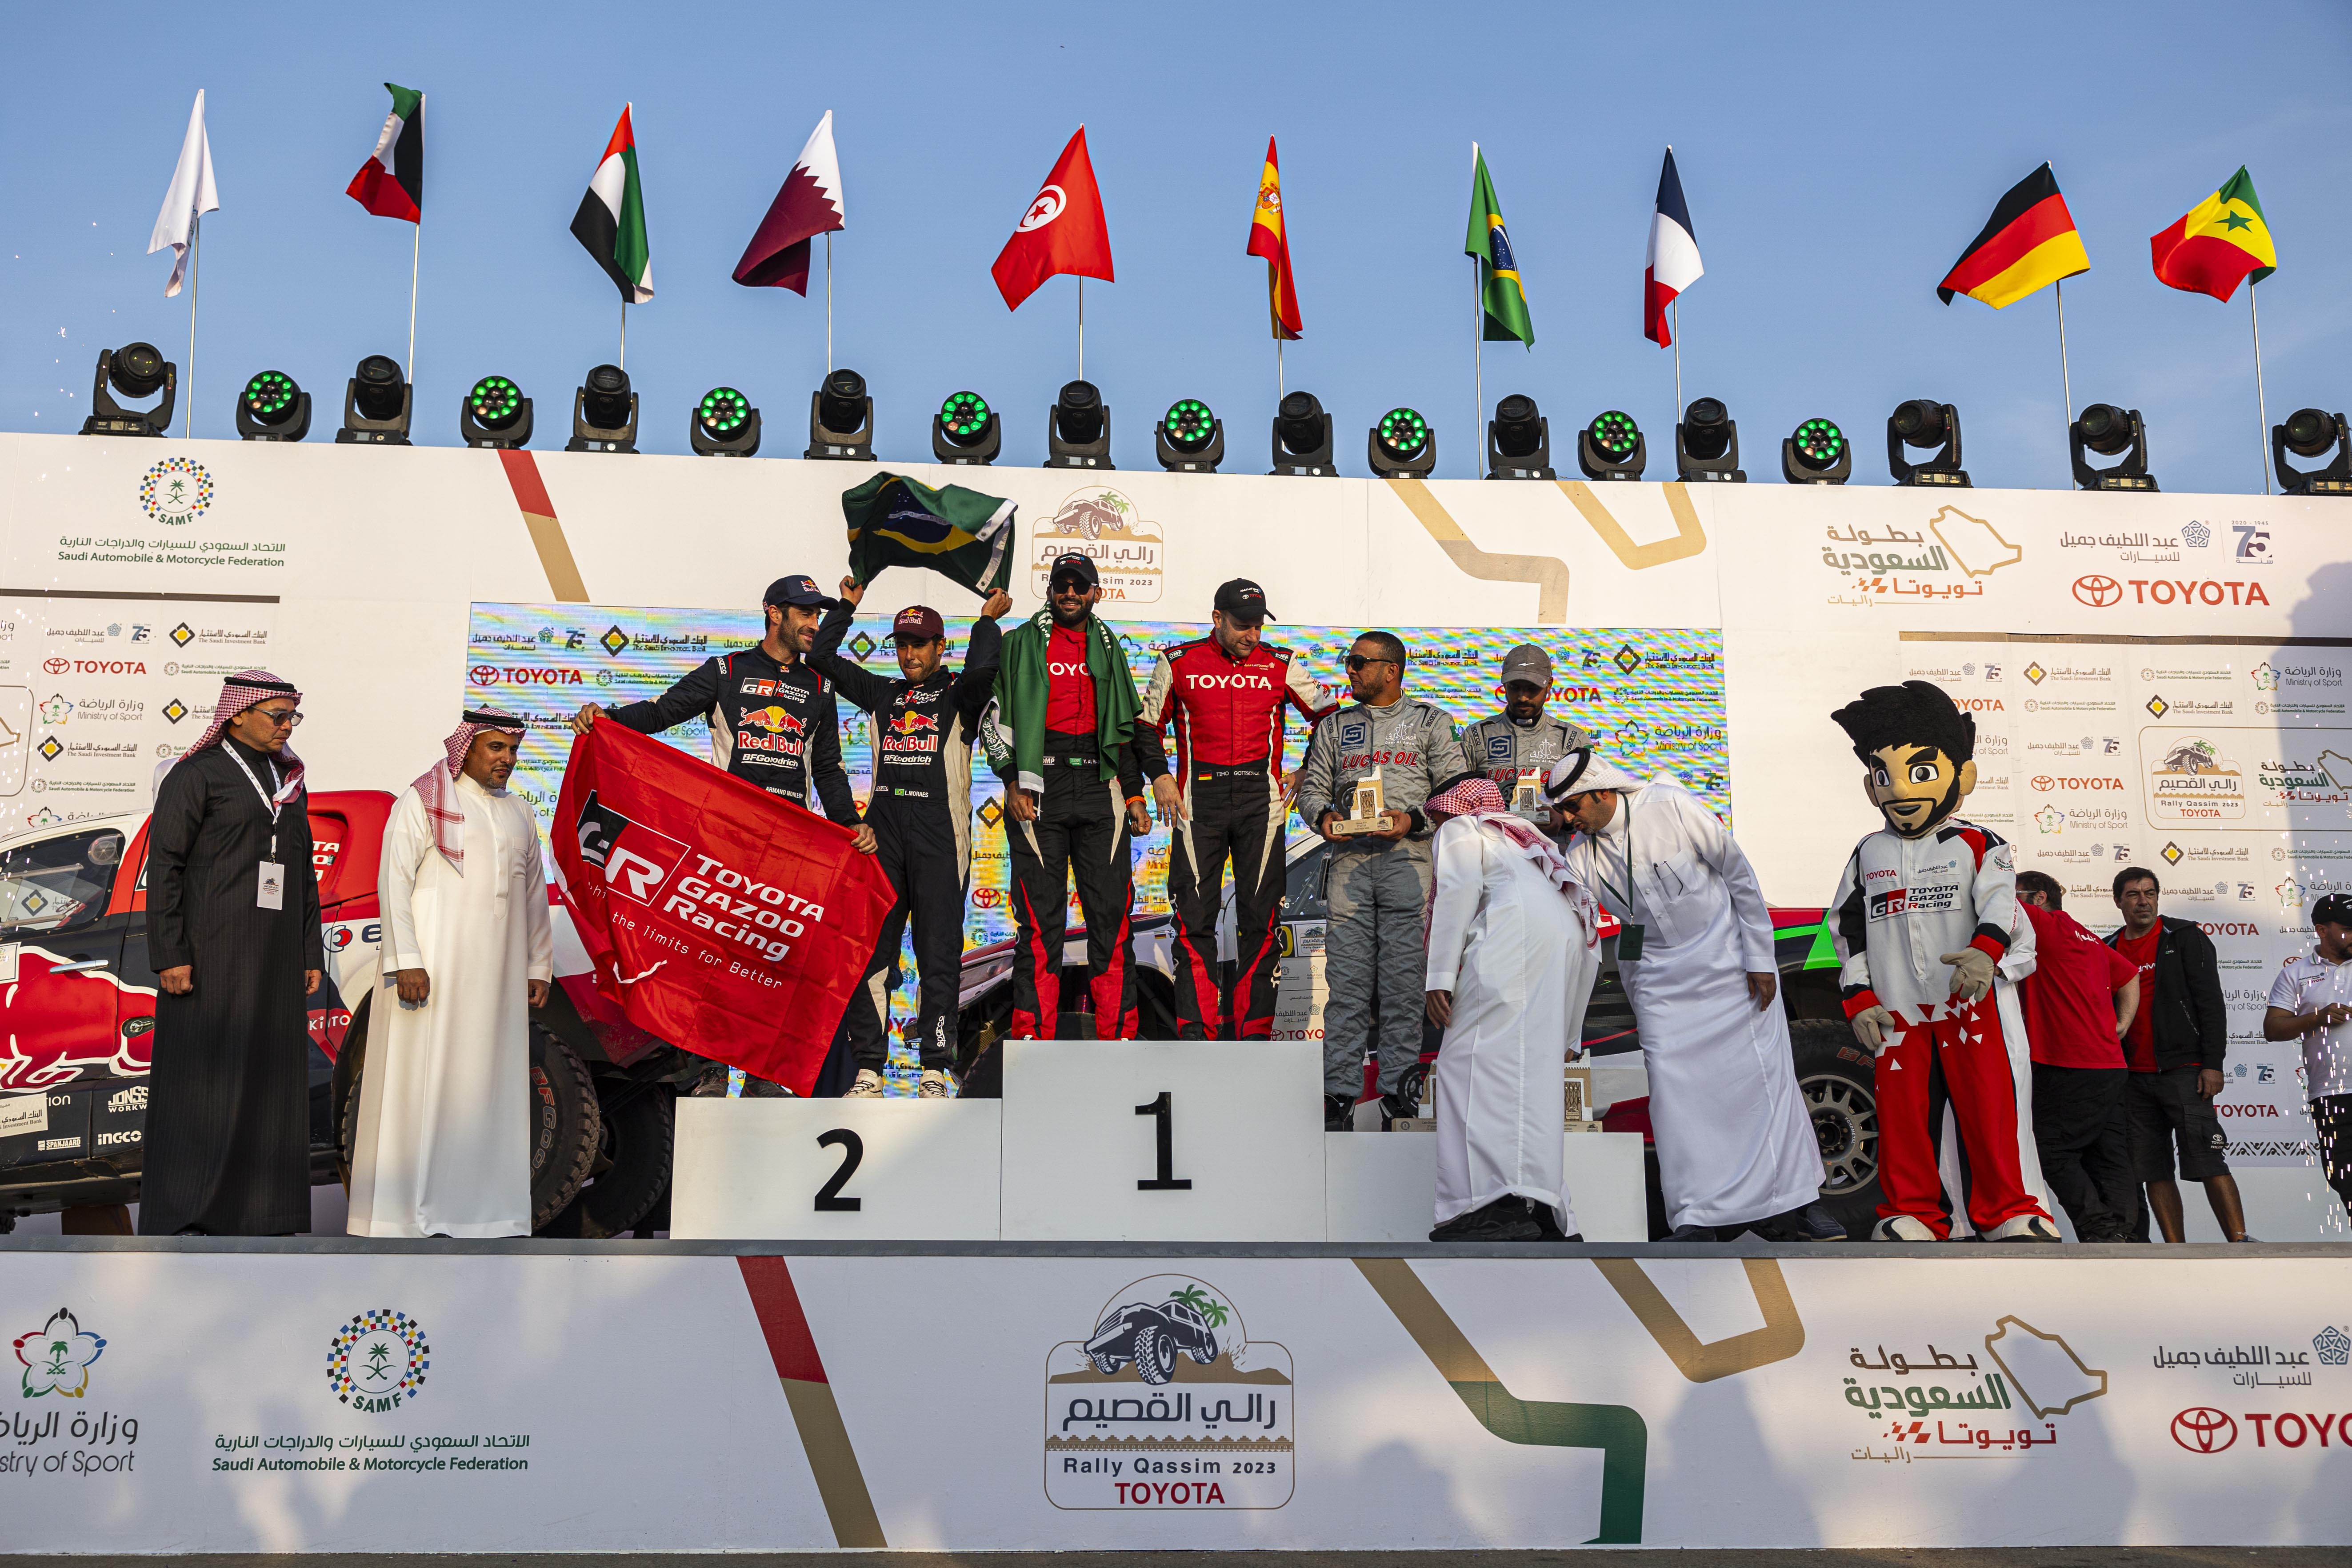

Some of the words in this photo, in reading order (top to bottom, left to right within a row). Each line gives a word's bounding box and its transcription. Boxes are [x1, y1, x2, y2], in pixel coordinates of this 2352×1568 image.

[158, 512, 193, 526] SAMF
[60, 536, 91, 547] النارية
[1827, 524, 1924, 546] بطولة
[2060, 531, 2095, 548] جميل
[2099, 533, 2148, 548] اللطيف
[2153, 536, 2178, 547] عبد
[95, 538, 144, 549] والدراجات
[148, 540, 196, 550] للسيارات
[199, 542, 248, 553] السعودي
[252, 543, 285, 552] الاتحاد
[58, 552, 88, 561] Saudi
[90, 552, 153, 562] Automobile
[156, 554, 164, 562] &
[166, 555, 225, 565] Motorcycle
[228, 556, 284, 566] Federation
[1114, 546, 1153, 564] رالي
[1822, 545, 1948, 575] السعودية
[2120, 551, 2180, 564] للسيارات
[1893, 578, 1983, 600] تويوتا
[2128, 580, 2270, 606] TOYOTA
[1828, 595, 1872, 607] راليات
[1169, 650, 1182, 659] OMP
[74, 661, 146, 674] TOYOTA
[716, 657, 727, 674] sparco
[2285, 666, 2316, 677] الرياضة
[2320, 667, 2341, 678] وزارة
[503, 668, 583, 685] TOYOTA
[1186, 674, 1272, 690] TOYOTA
[2286, 679, 2312, 687] Ministry
[2323, 679, 2343, 687] Sport
[742, 684, 773, 695] GR
[778, 688, 806, 698] GAZOO
[780, 683, 809, 695] TOYOTA
[79, 699, 115, 711] الرياضة
[119, 700, 144, 711] وزارة
[777, 692, 805, 704] Racing
[78, 711, 107, 721] Ministry
[119, 712, 142, 721] Sport
[1425, 710, 1440, 728] sparco
[670, 726, 680, 736] of
[681, 726, 705, 737] Sport
[1472, 726, 1481, 746] sparco
[1656, 726, 1691, 739] الرياضة
[1696, 726, 1721, 740] وزارة
[738, 731, 775, 751] Red
[776, 735, 804, 756] Bull
[882, 735, 906, 752] Red
[905, 735, 938, 752] Bull
[1566, 730, 1577, 751] sparco
[742, 754, 798, 768] BFGoodrich
[884, 755, 931, 763] BFGoodrich
[1342, 750, 1392, 771] LUCAS
[1394, 751, 1419, 768] OIL
[2261, 760, 2315, 773] بطولة
[1487, 768, 1536, 782] LUCAS
[2259, 772, 2329, 790] السعودية
[766, 786, 786, 795] ARMAND
[2057, 778, 2124, 790] TOYOTA
[2159, 777, 2205, 791] القصيم
[2209, 779, 2236, 791] رالي
[2180, 809, 2221, 817] TOYOTA
[1866, 870, 1897, 880] TOYOTA
[696, 853, 825, 922] TOYOTA
[1909, 885, 1959, 895] TOYOTA
[1908, 901, 1951, 909] Racing
[1909, 893, 1953, 902] GAZOO
[677, 876, 805, 937] GAZOO
[1872, 898, 1904, 917] GR
[663, 895, 790, 962] Racing
[2196, 922, 2259, 936] TOYOTA
[612, 911, 635, 930] the
[643, 925, 689, 955] limits
[699, 950, 722, 970] for
[729, 961, 783, 988] Better
[936, 1016, 946, 1047] sparco
[1287, 1029, 1324, 1040] TOYO
[2213, 1104, 2279, 1118] TOYOTA
[3, 1121, 29, 1129] Investment
[1844, 1117, 1856, 1144] FONDMETAL
[46, 1139, 80, 1148] SPANJAARD
[1135, 1091, 1192, 1191] 1
[815, 1128, 864, 1212] 2
[1849, 1344, 1979, 1377] بطولة
[2153, 1344, 2200, 1369] جميل
[2204, 1346, 2270, 1367] اللطيف
[2275, 1349, 2310, 1366] عبد
[2233, 1371, 2312, 1389] للسيارات
[352, 1391, 404, 1414] SAMF
[1843, 1373, 2012, 1419] السعودية
[1063, 1392, 1192, 1432] القصيم
[1201, 1393, 1276, 1430] رالي
[0, 1411, 58, 1446] الريا
[70, 1411, 140, 1446] وزارة
[1939, 1421, 2057, 1451] تويوتا
[2245, 1412, 2352, 1448] TOY
[214, 1433, 259, 1450] النارية
[264, 1433, 334, 1452] والدراجات
[339, 1435, 405, 1452] للسيارات
[410, 1435, 478, 1453] السعودي
[483, 1435, 530, 1449] الاتحاد
[1851, 1445, 1912, 1464] راليات
[0, 1450, 36, 1478] stry
[43, 1451, 68, 1473] of
[72, 1450, 135, 1477] Sport
[212, 1457, 253, 1472] Saudi
[258, 1457, 346, 1472] Automobile
[348, 1458, 361, 1472] &
[363, 1457, 446, 1475] Motorcycle
[450, 1457, 528, 1472] Federation
[1064, 1458, 1123, 1478] Rally
[1134, 1458, 1221, 1475] Qassim
[1232, 1462, 1276, 1475] 2023
[1114, 1482, 1226, 1505] TOYOTA
